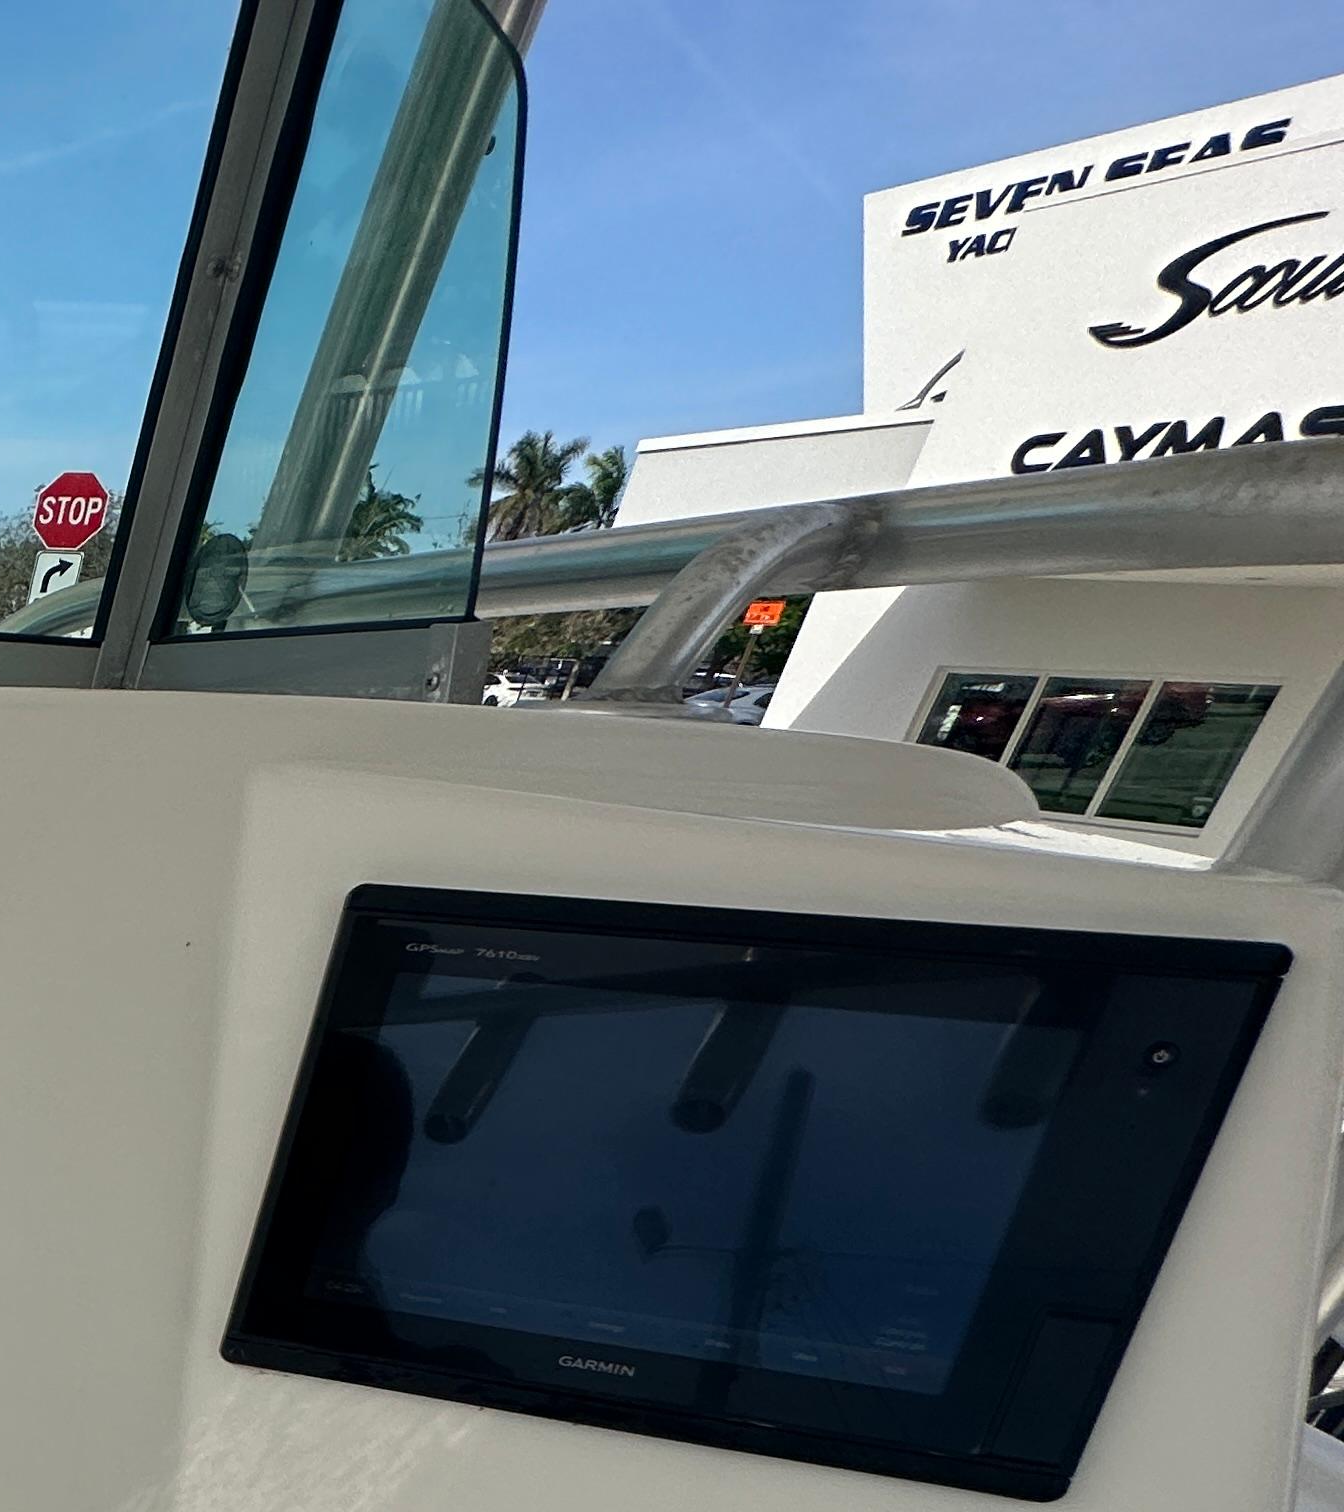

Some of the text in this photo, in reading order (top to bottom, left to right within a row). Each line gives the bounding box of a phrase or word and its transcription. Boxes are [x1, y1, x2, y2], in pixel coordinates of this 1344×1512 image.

[901, 165, 1094, 237] SEVEN
[39, 496, 103, 525] STOP
[558, 1354, 636, 1377] GARMIN
